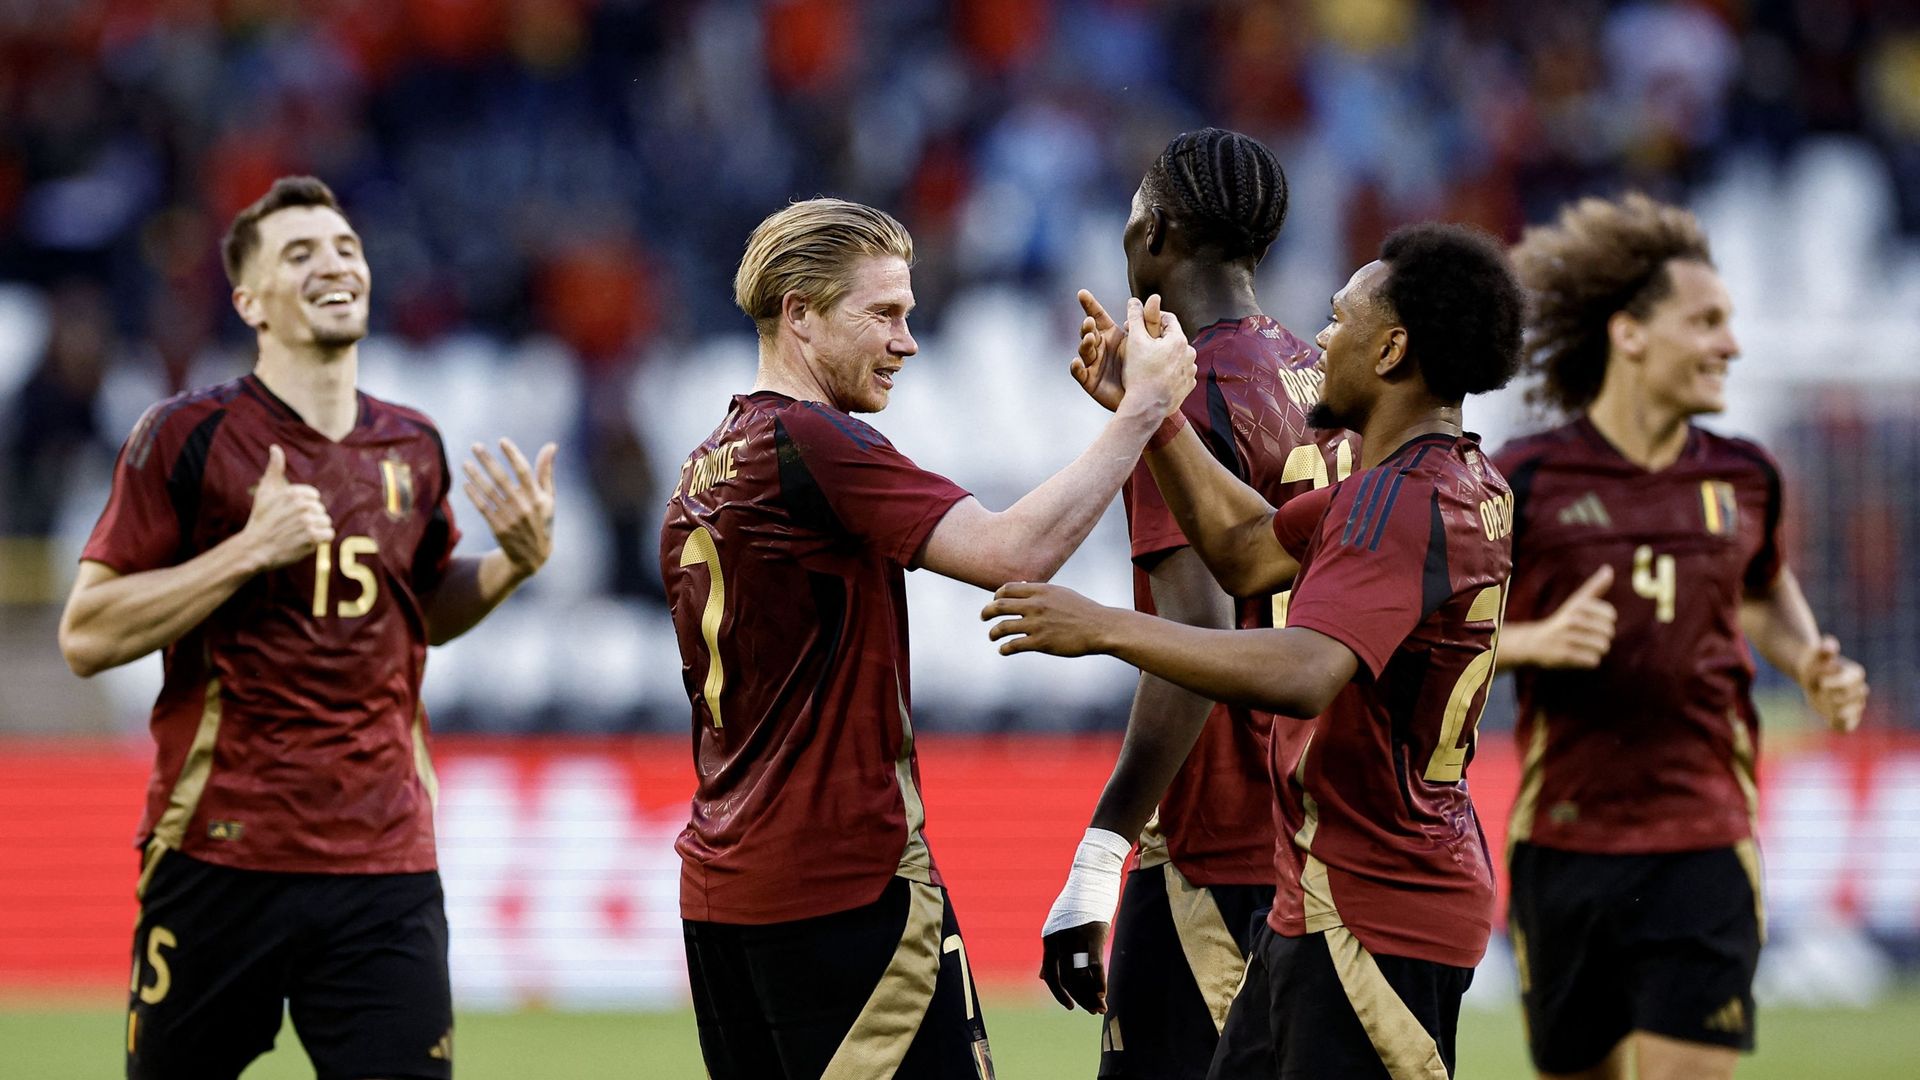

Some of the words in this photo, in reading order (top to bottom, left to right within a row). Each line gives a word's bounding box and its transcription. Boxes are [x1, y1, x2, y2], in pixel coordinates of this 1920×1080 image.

[312, 535, 379, 618] 15
[1631, 543, 1677, 625] 4
[679, 526, 725, 728] 7
[1423, 574, 1511, 782] 2
[943, 933, 974, 1020] 7
